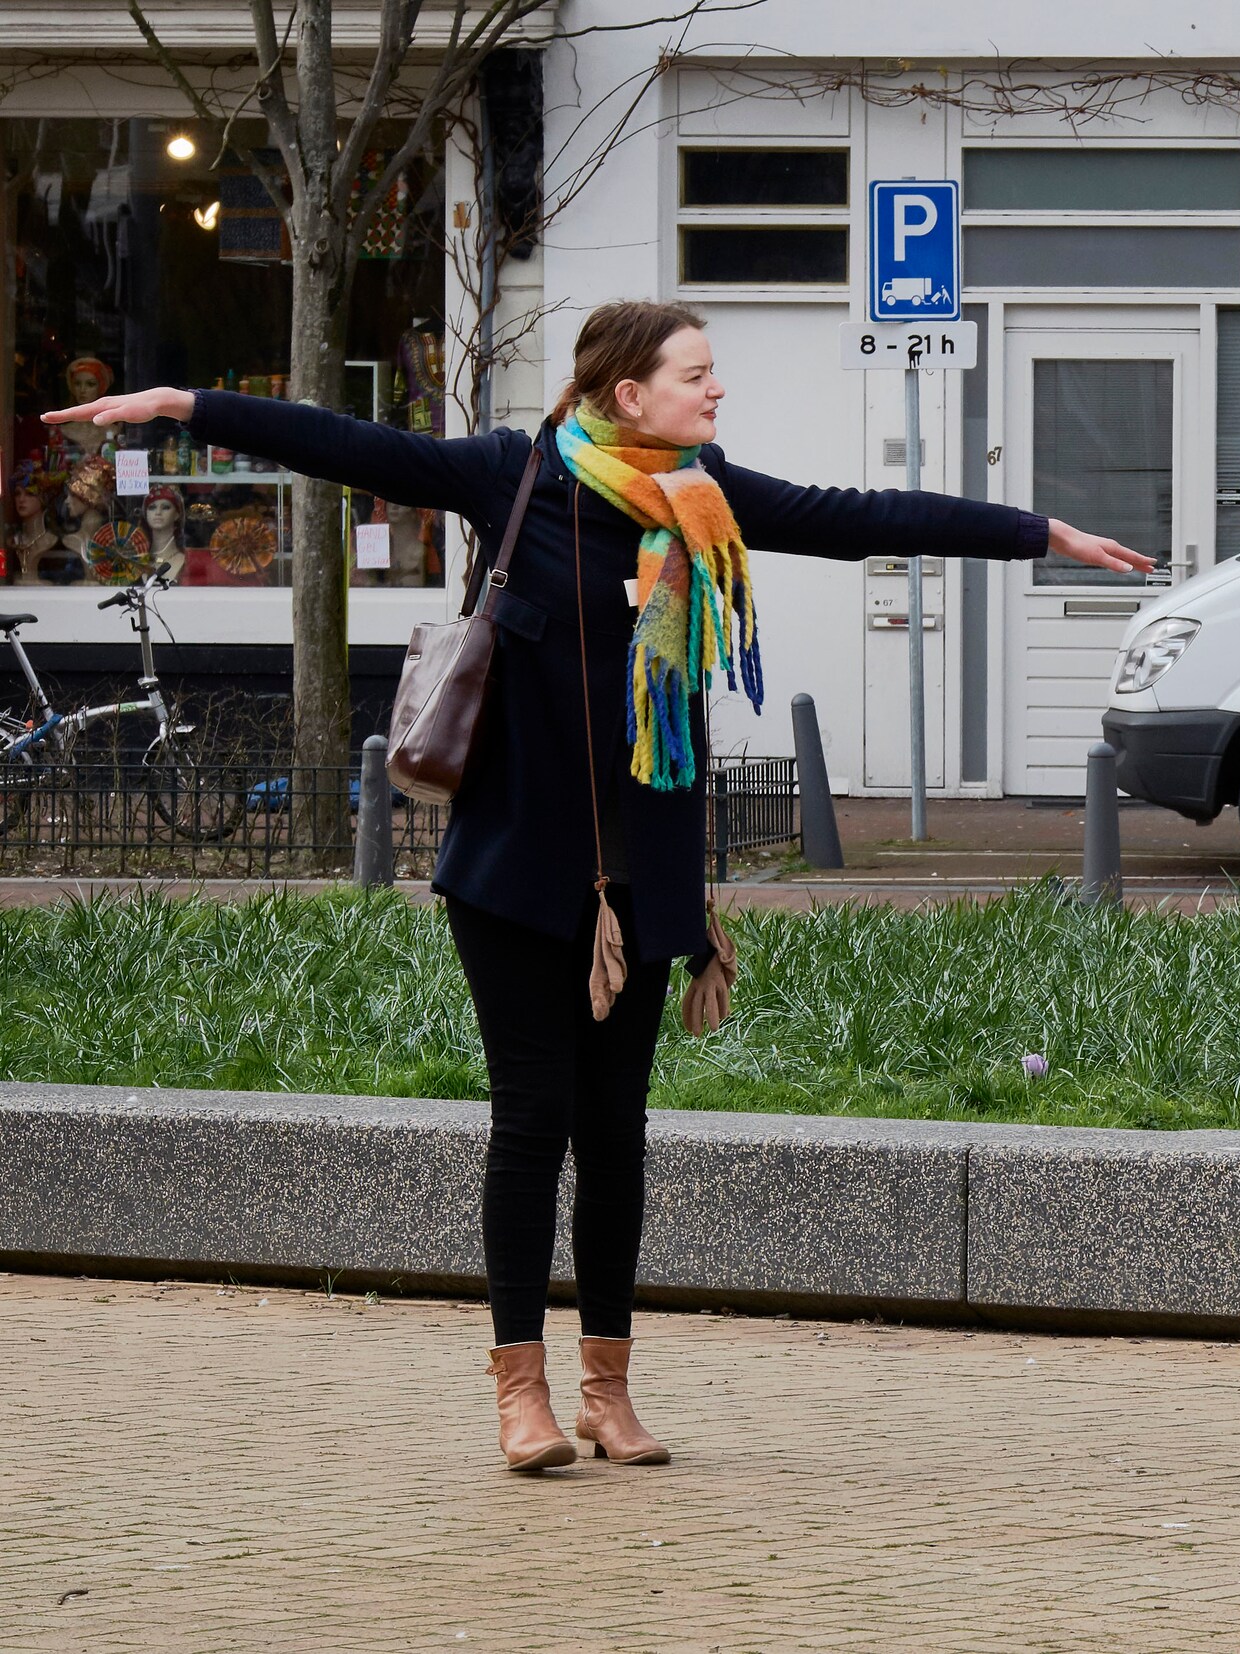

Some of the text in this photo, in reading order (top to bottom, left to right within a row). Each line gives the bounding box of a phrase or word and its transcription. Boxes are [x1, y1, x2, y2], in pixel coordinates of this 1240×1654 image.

[893, 194, 938, 261] P
[860, 334, 876, 354] 8
[907, 334, 931, 354] 21
[941, 334, 955, 354] h
[987, 446, 1002, 466] 67
[883, 599, 893, 607] 67
